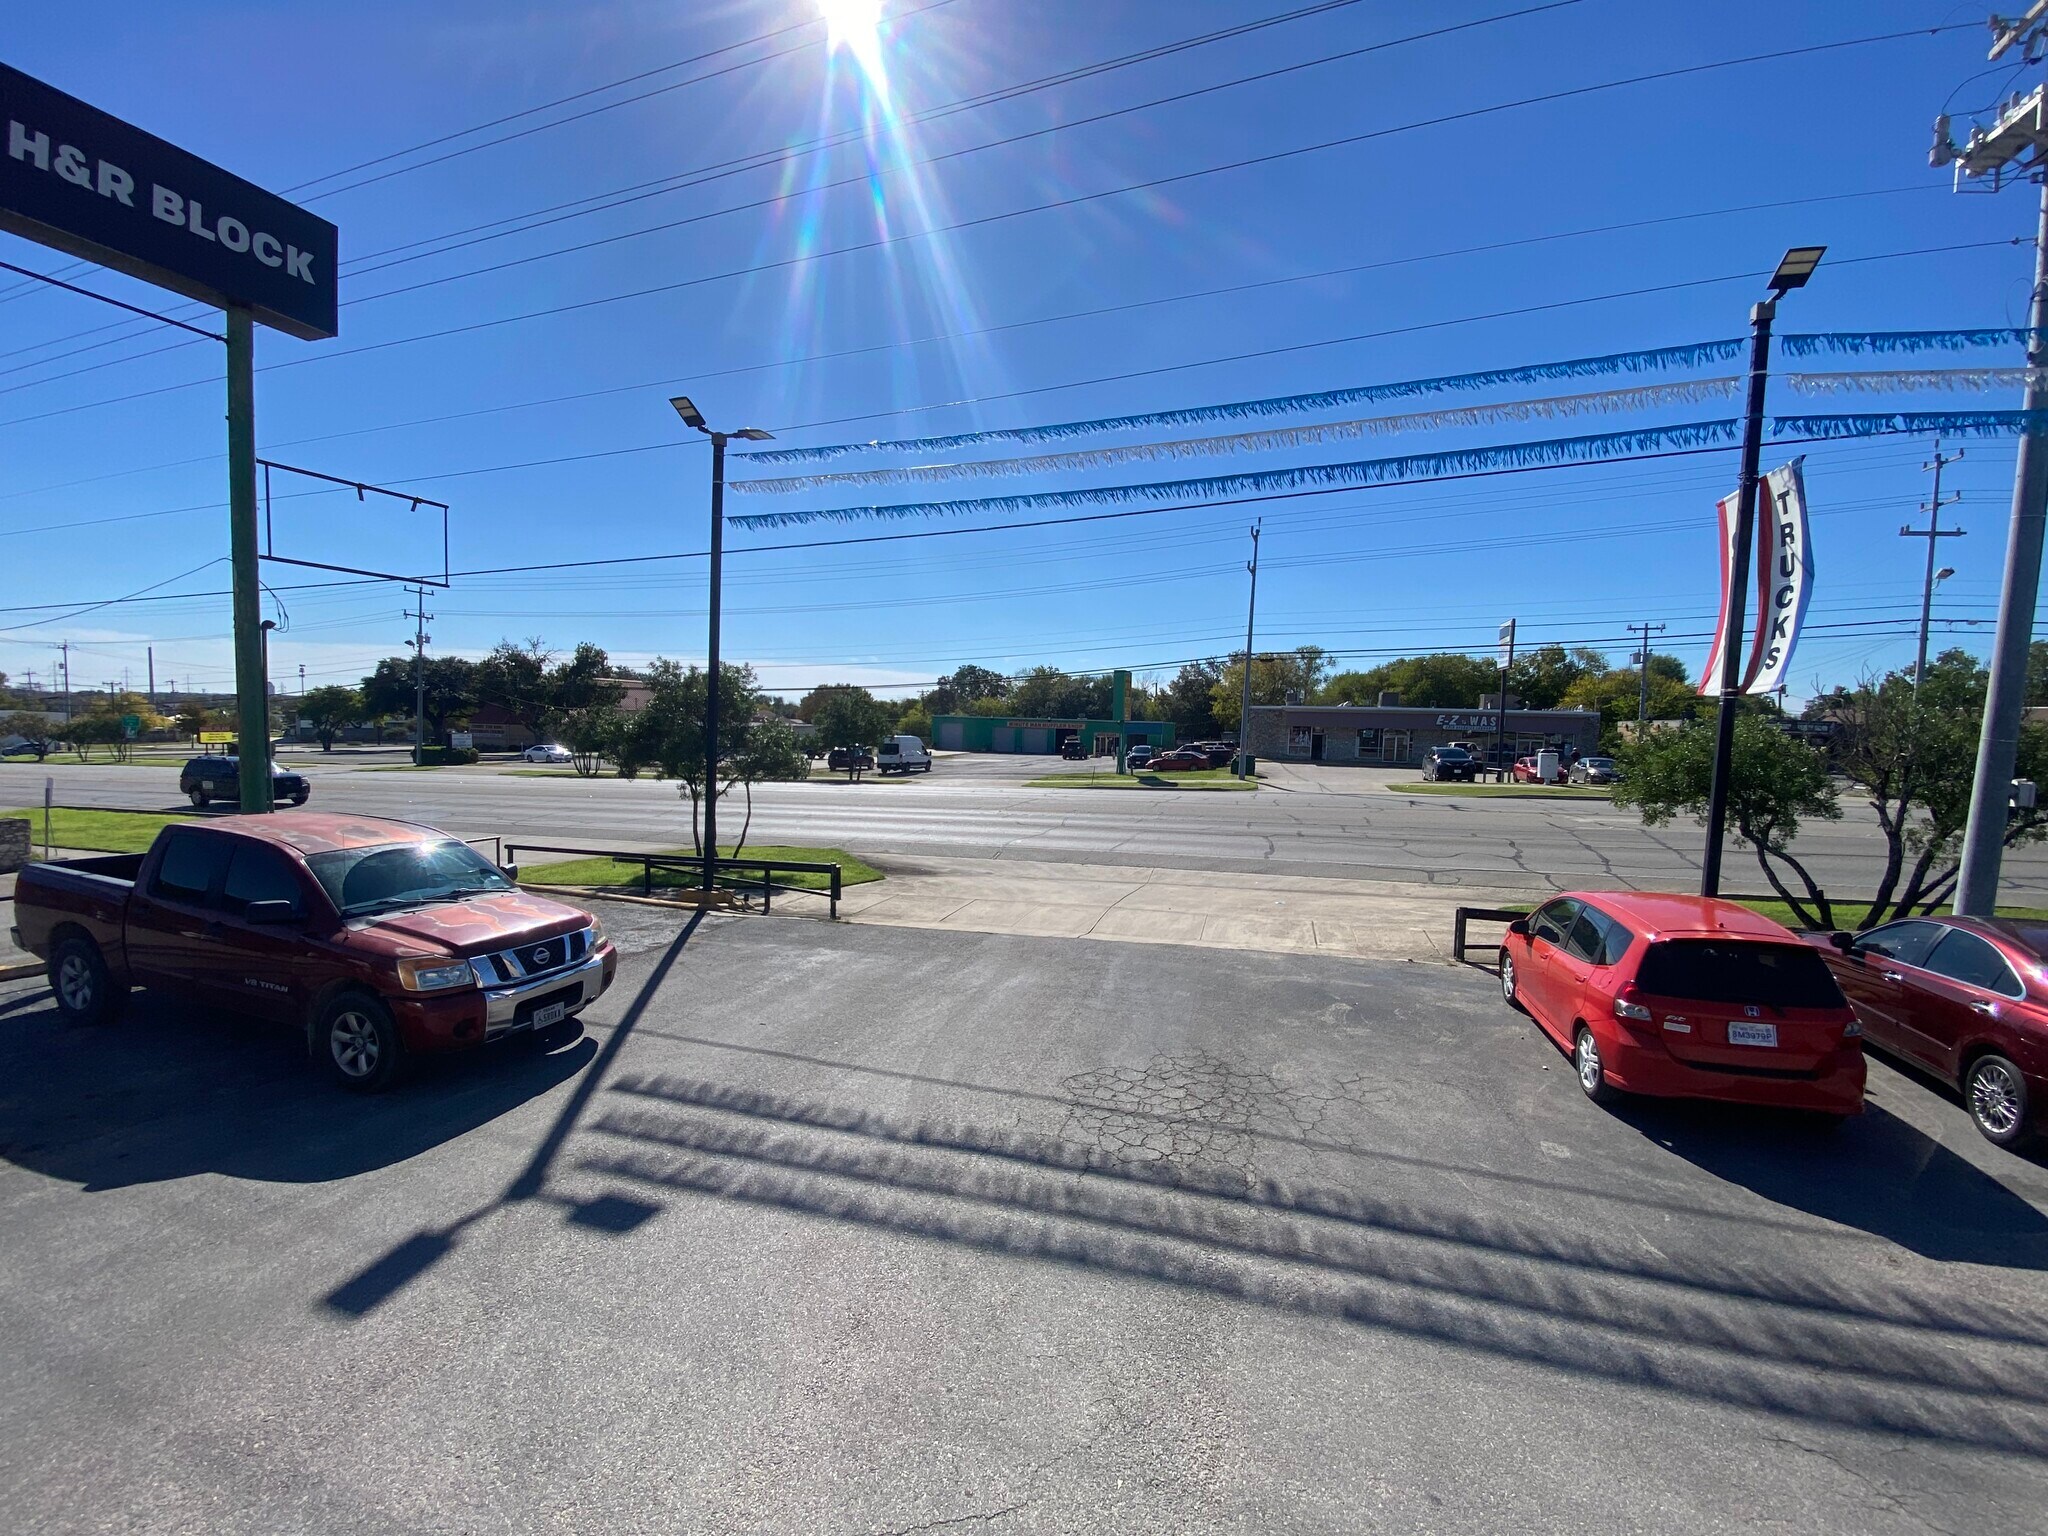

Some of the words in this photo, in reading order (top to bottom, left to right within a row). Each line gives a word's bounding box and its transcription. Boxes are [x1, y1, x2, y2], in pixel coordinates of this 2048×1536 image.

[9, 119, 135, 208] H&R
[152, 183, 316, 285] BLOCK
[1765, 490, 1795, 670] TRUCKS
[1436, 714, 1460, 726] E-Z
[259, 980, 288, 992] TITAN
